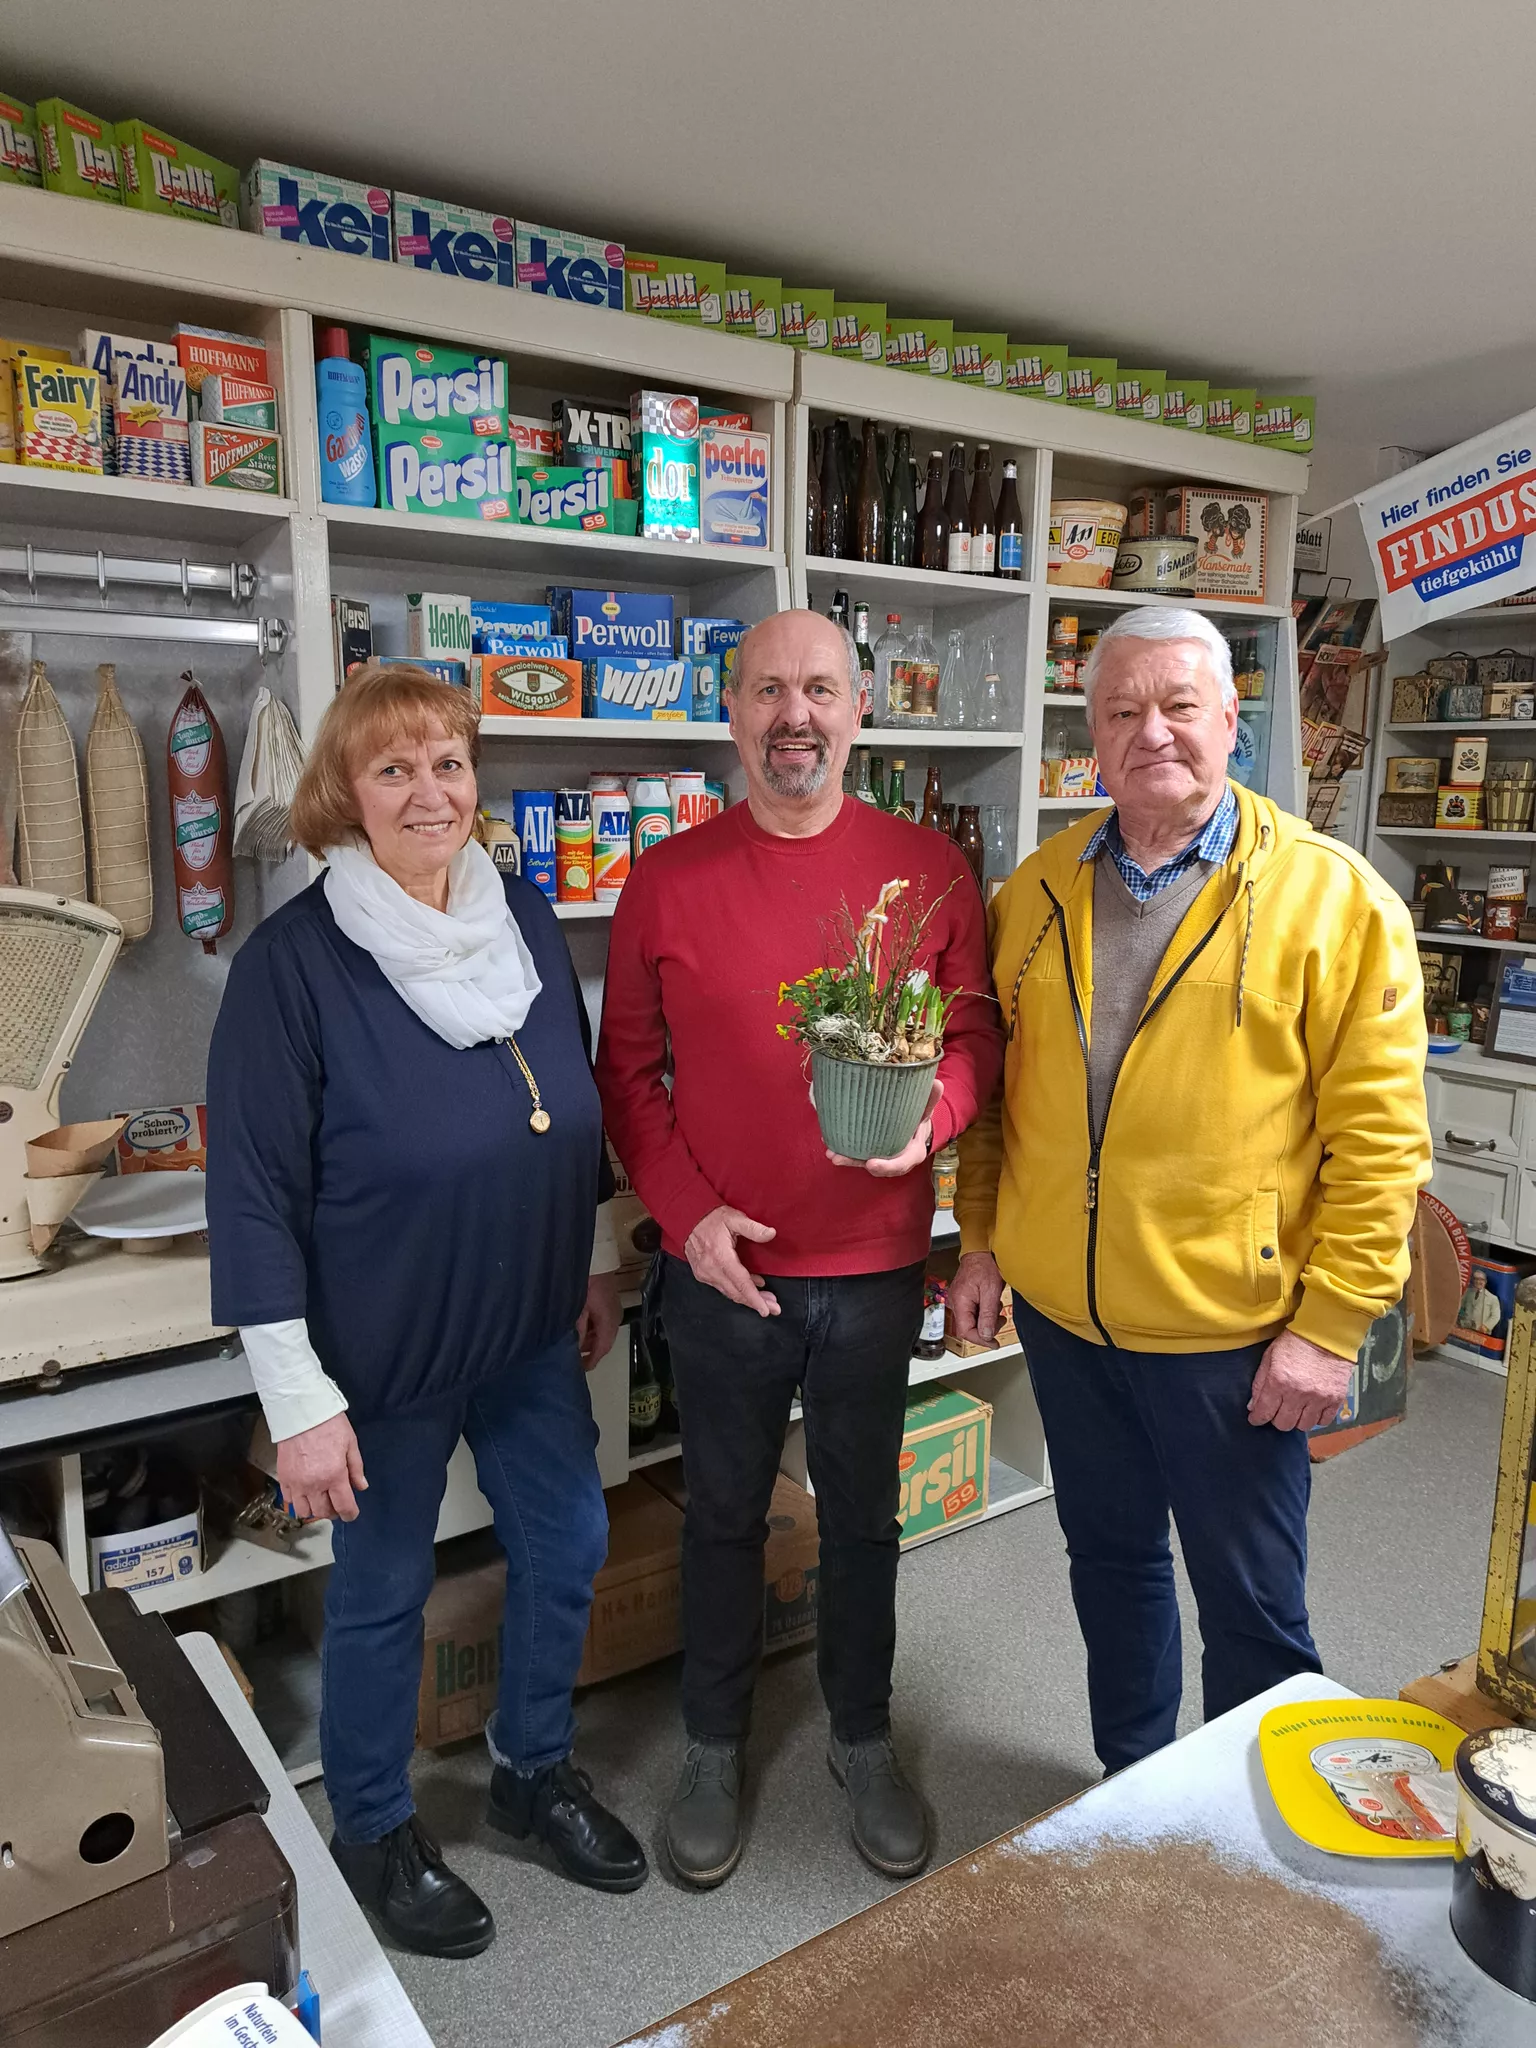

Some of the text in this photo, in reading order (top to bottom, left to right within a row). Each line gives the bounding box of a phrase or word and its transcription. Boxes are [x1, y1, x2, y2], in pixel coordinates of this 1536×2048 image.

[278, 177, 390, 261] kei
[412, 209, 514, 287] kei
[530, 237, 623, 311] kei
[629, 272, 698, 310] Dalli
[725, 289, 754, 325] lli
[725, 300, 765, 322] zial
[832, 315, 859, 349] lli
[832, 324, 871, 349] zial
[886, 331, 927, 366] alli
[24, 365, 98, 409] Fairy
[121, 363, 184, 416] Andy
[1006, 356, 1044, 389] alli
[382, 356, 505, 424] Persil
[474, 418, 500, 432] 59
[567, 408, 632, 450] X-TR
[1255, 406, 1292, 436] alli
[248, 458, 277, 471] Stärke
[647, 447, 697, 502] dor
[704, 438, 767, 480] perla
[389, 444, 513, 512] Persil
[1380, 449, 1532, 529] Hier finden Sie
[482, 502, 508, 516] 59
[583, 514, 606, 528] 59
[1101, 532, 1120, 546] EDE
[1296, 529, 1323, 547] eblatt
[1387, 479, 1536, 580] FINDUS
[1115, 557, 1138, 570] deka
[1419, 543, 1518, 595] tiefgekühlt
[341, 602, 370, 633] Persil
[428, 604, 471, 650] Henko
[471, 616, 548, 636] Perwoll
[574, 615, 672, 649] Perwoll
[488, 638, 568, 660] Perwoll
[600, 658, 686, 712] wipp
[555, 793, 592, 820] ATA
[522, 806, 556, 853] ATA
[494, 847, 516, 864] ATA
[131, 1125, 184, 1140] probiert?"
[138, 1118, 175, 1129] "Schon
[1423, 1195, 1457, 1228] SPAREN
[1451, 1227, 1470, 1257] BEIM
[900, 1424, 979, 1527] ersil
[946, 1483, 975, 1513] 59
[105, 1557, 140, 1572] adidas
[145, 1566, 166, 1579] 157
[1307, 1714, 1364, 1727] Gewissens
[223, 2013, 240, 2031] im
[242, 2002, 278, 2045] Naturfein
